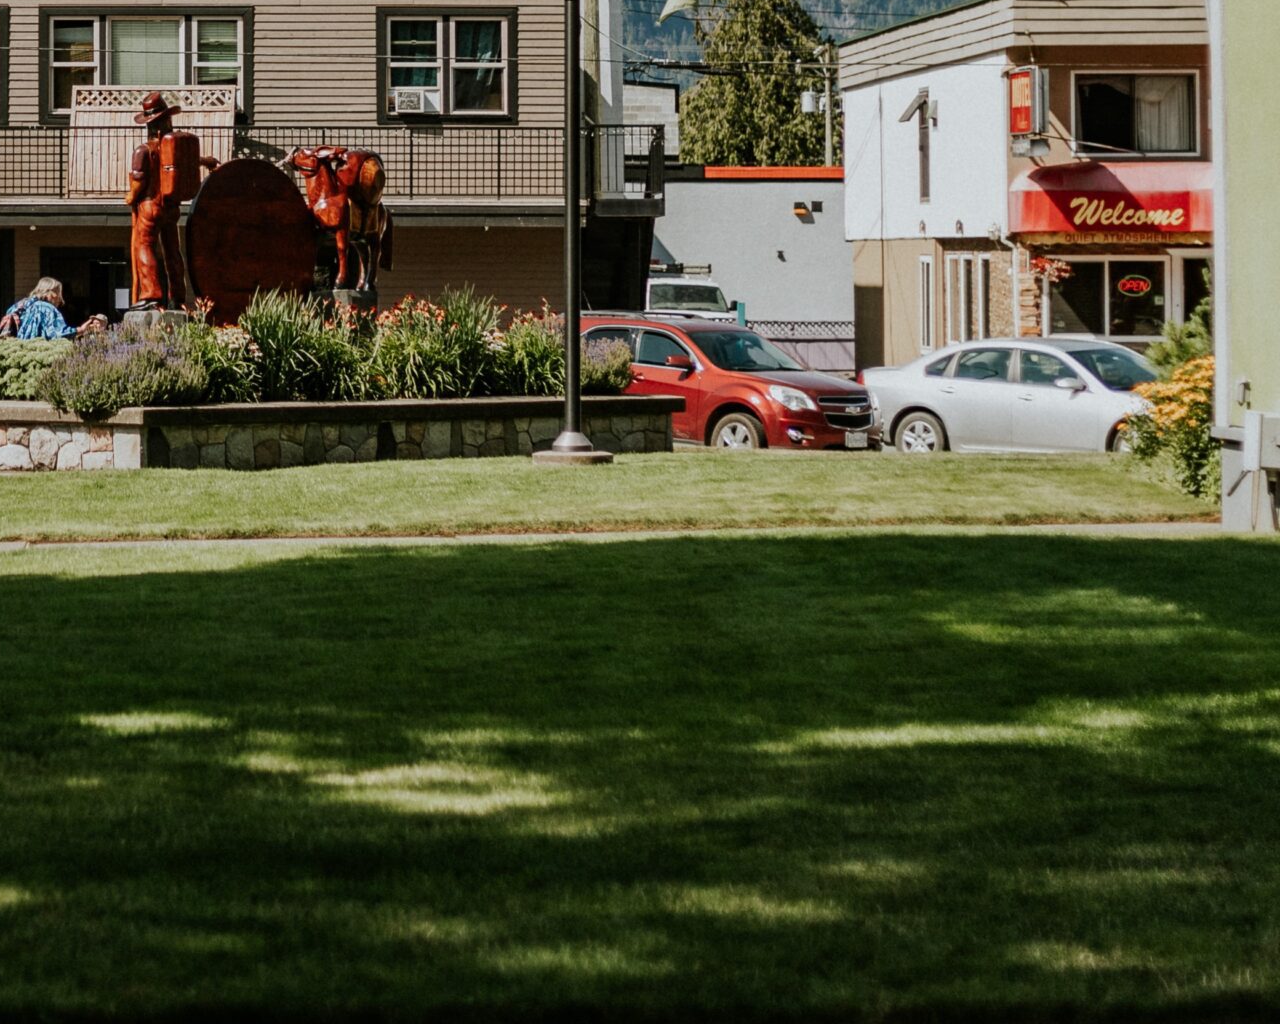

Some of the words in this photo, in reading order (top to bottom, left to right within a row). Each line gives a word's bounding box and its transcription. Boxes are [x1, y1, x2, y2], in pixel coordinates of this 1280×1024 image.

[1070, 197, 1185, 225] Welcome
[1064, 233, 1096, 243] QUIET
[1104, 232, 1174, 243] ATMOSPHERE
[1120, 279, 1149, 291] OPEN
